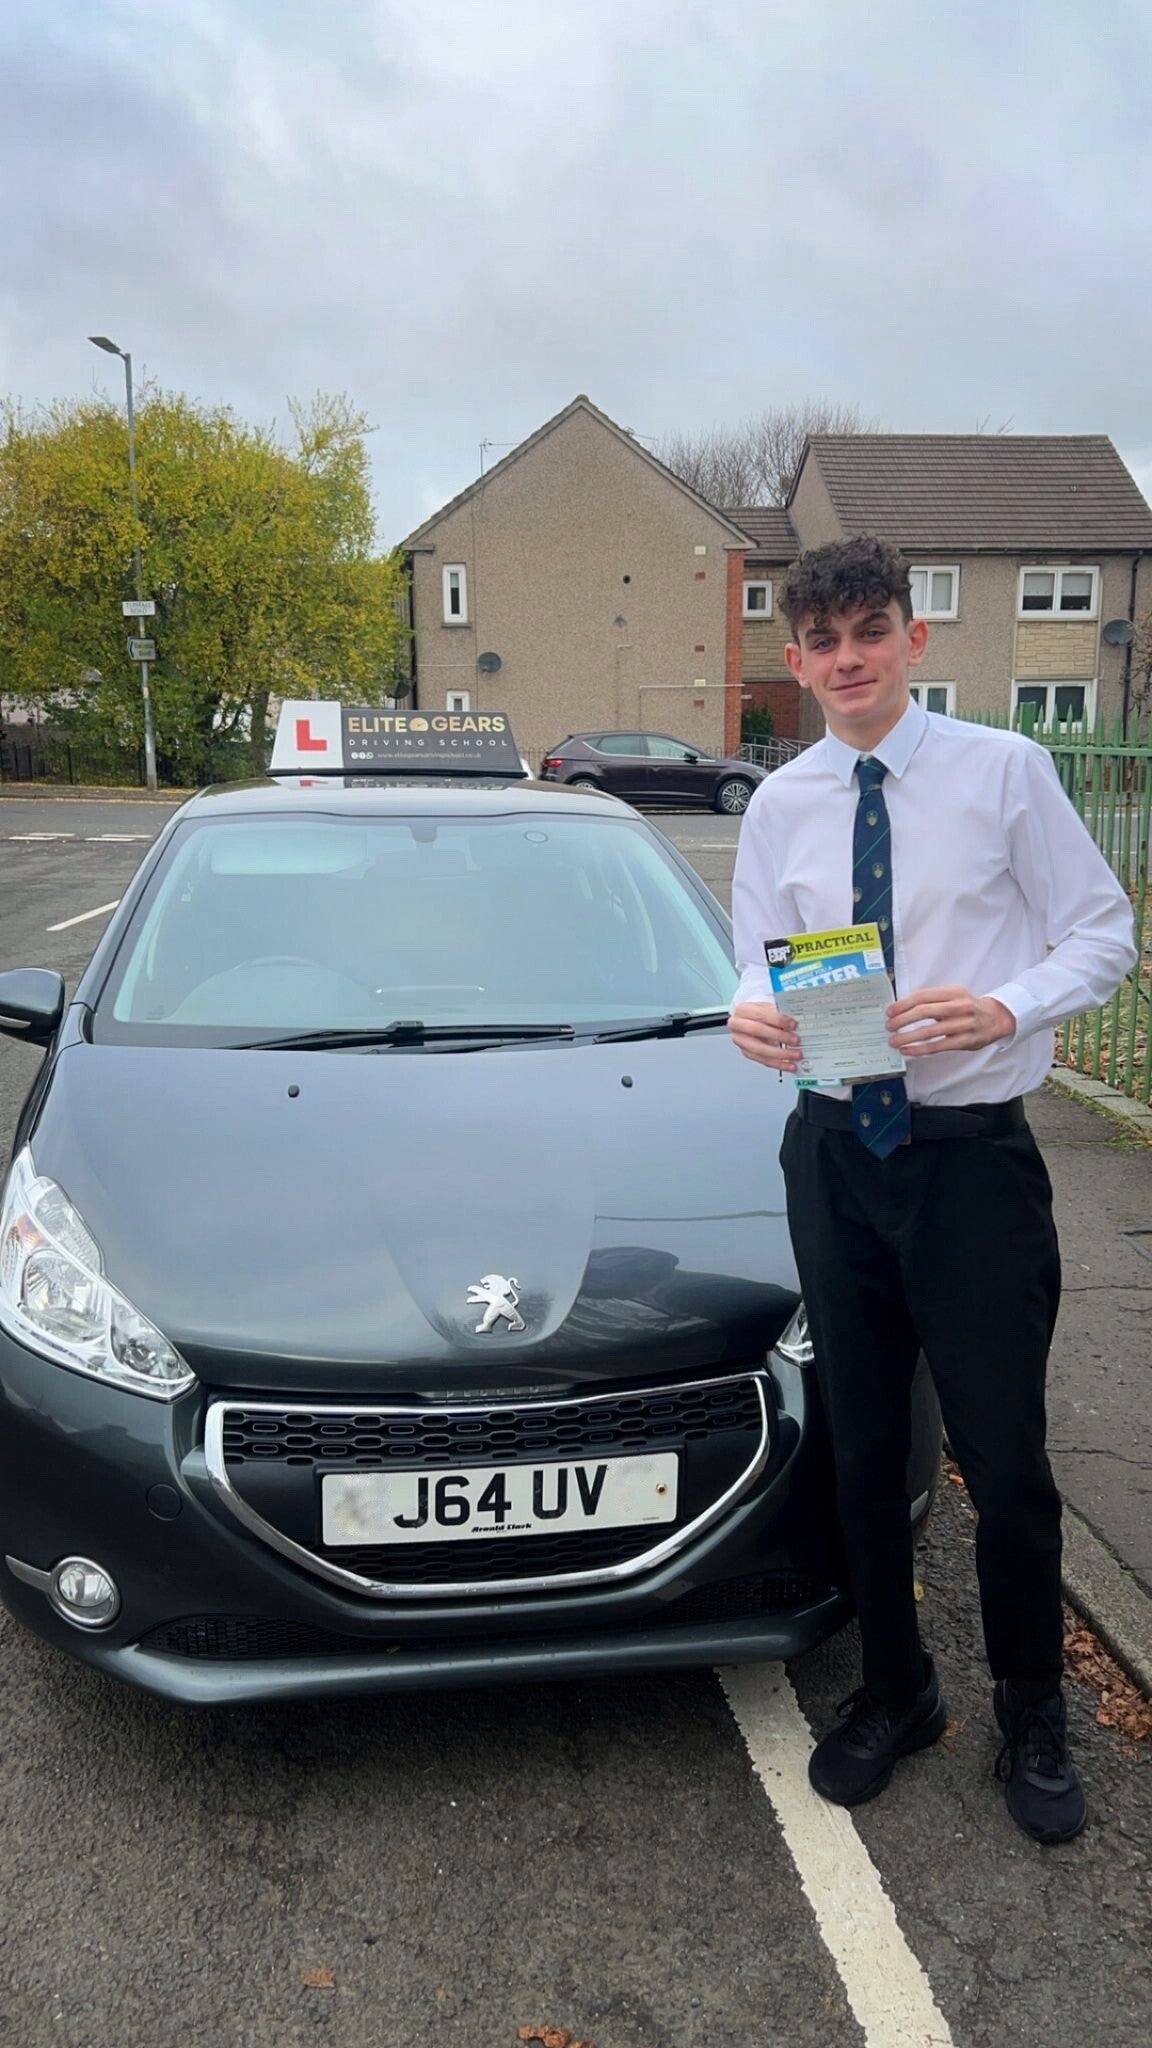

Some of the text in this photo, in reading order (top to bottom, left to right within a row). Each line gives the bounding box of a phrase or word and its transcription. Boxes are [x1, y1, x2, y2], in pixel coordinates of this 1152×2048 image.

[296, 720, 327, 751] L
[348, 716, 505, 733] ELITE GEARS
[795, 932, 874, 954] PRACTICAL
[393, 1464, 608, 1529] J64 UV
[471, 1522, 532, 1533] Arnold Clark
